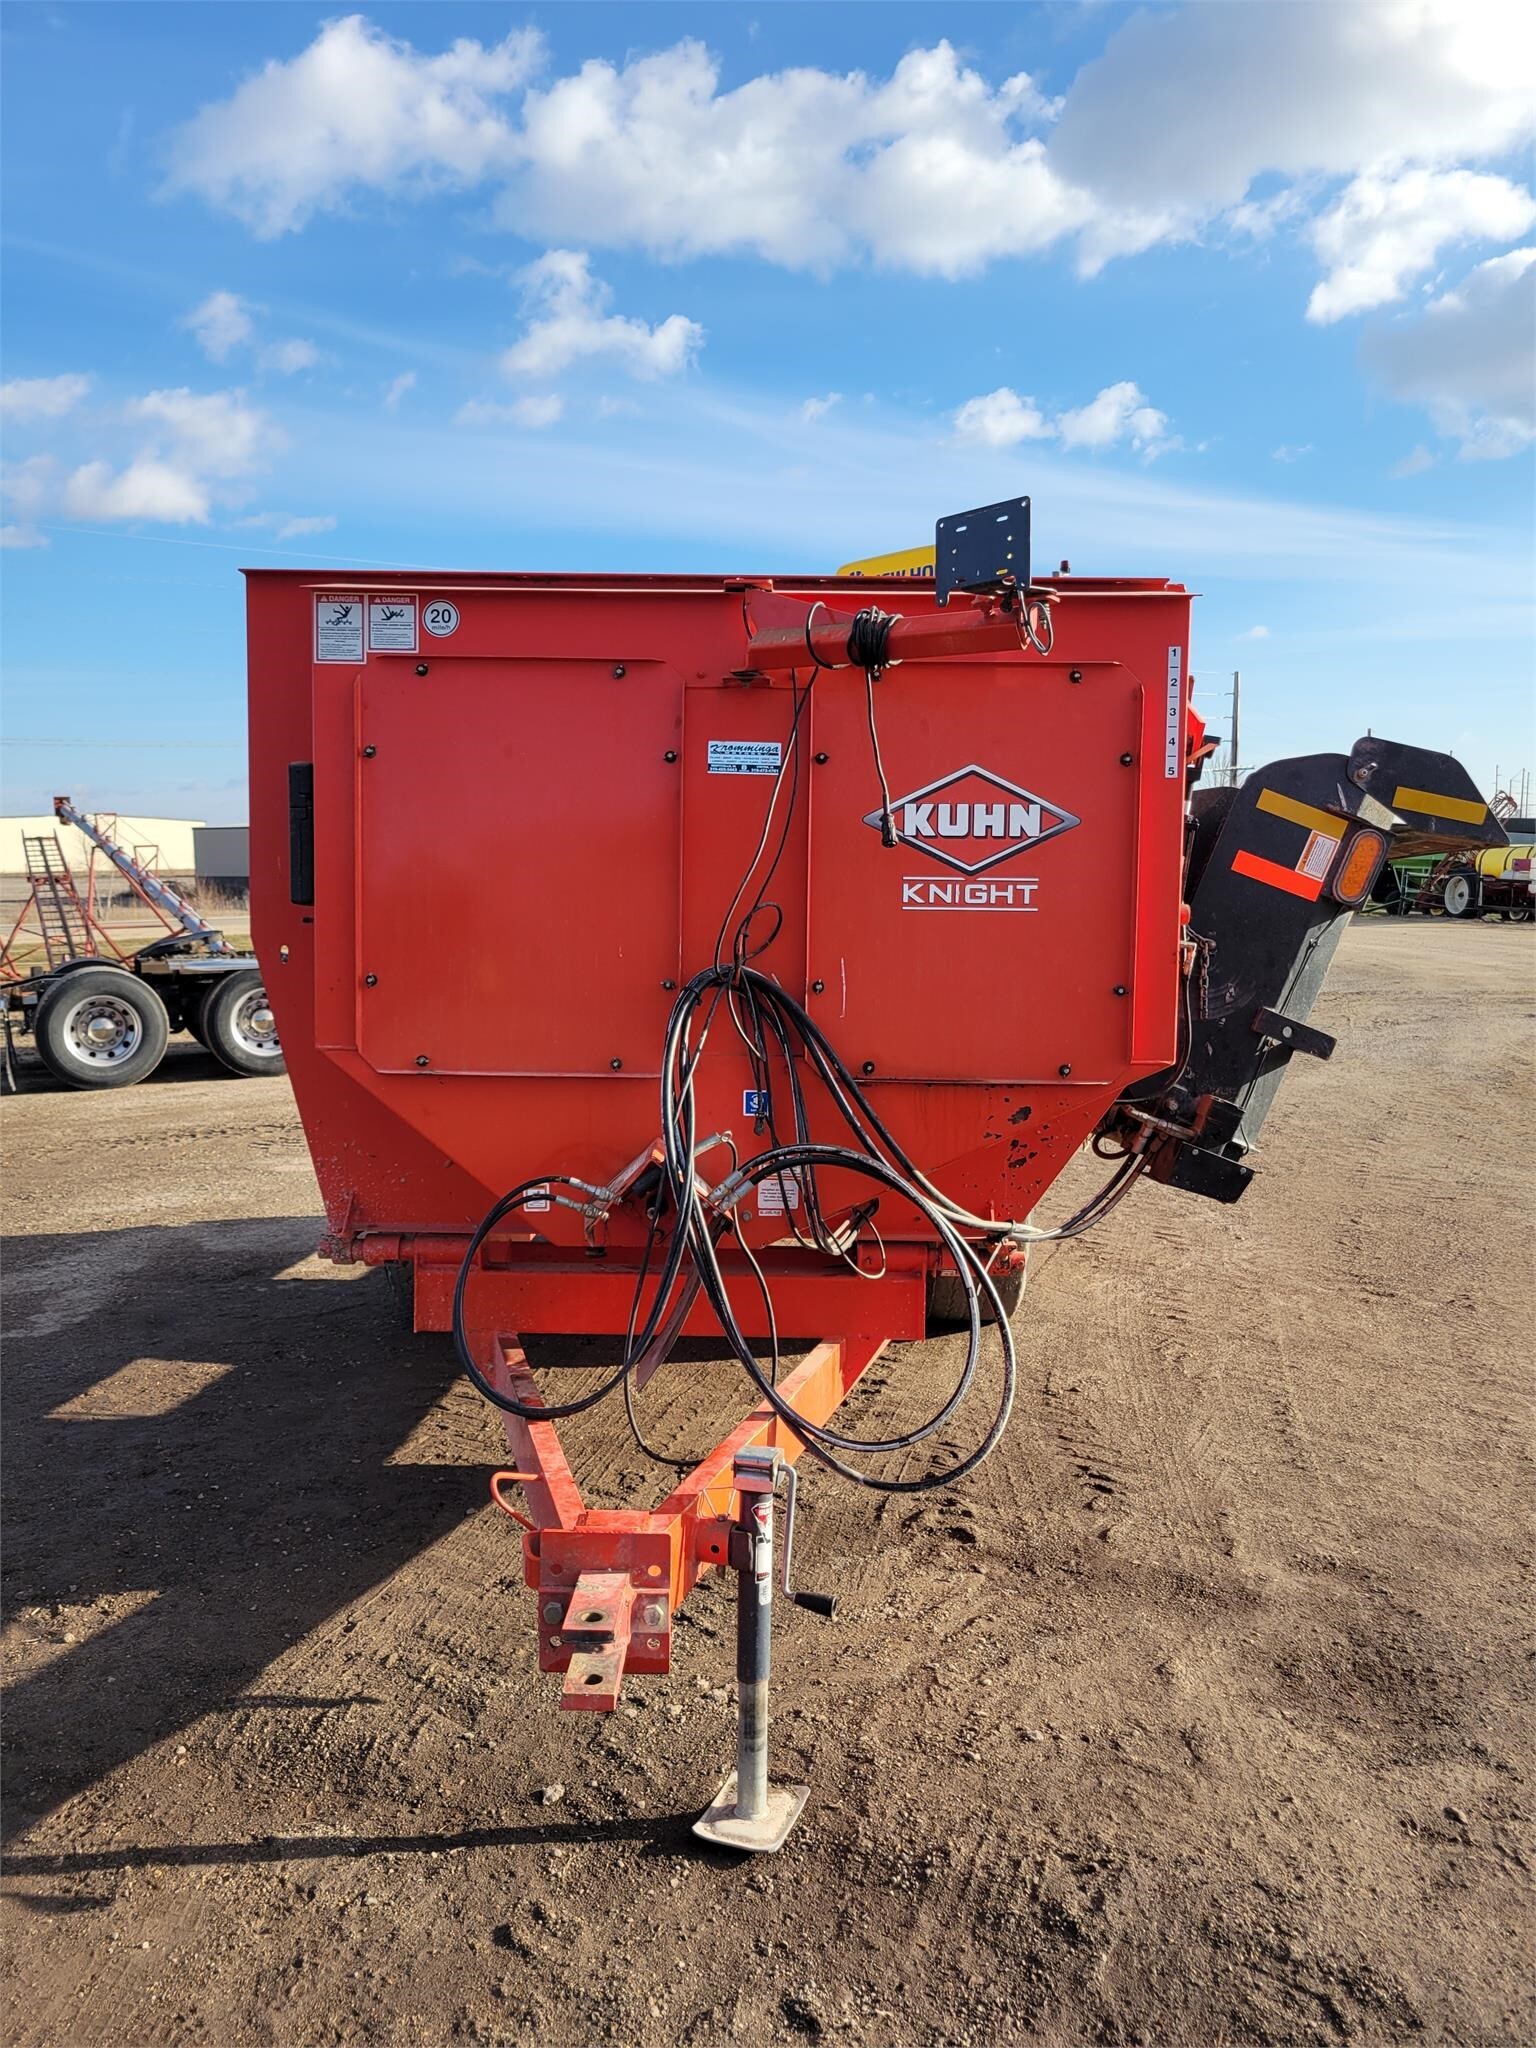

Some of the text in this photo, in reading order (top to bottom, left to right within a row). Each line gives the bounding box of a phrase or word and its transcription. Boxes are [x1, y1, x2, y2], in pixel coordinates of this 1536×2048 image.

[328, 595, 360, 603] DANGER
[381, 596, 411, 604] DANGER
[430, 608, 452, 624] 20
[1171, 648, 1177, 657] 1
[1170, 678, 1178, 687] 2
[1169, 707, 1177, 716] 3
[1168, 737, 1176, 746] 4
[710, 744, 779, 755] Kromminga
[1167, 767, 1175, 776] 5
[903, 803, 1041, 838] KUHN
[902, 883, 1039, 905] KNIGHT
